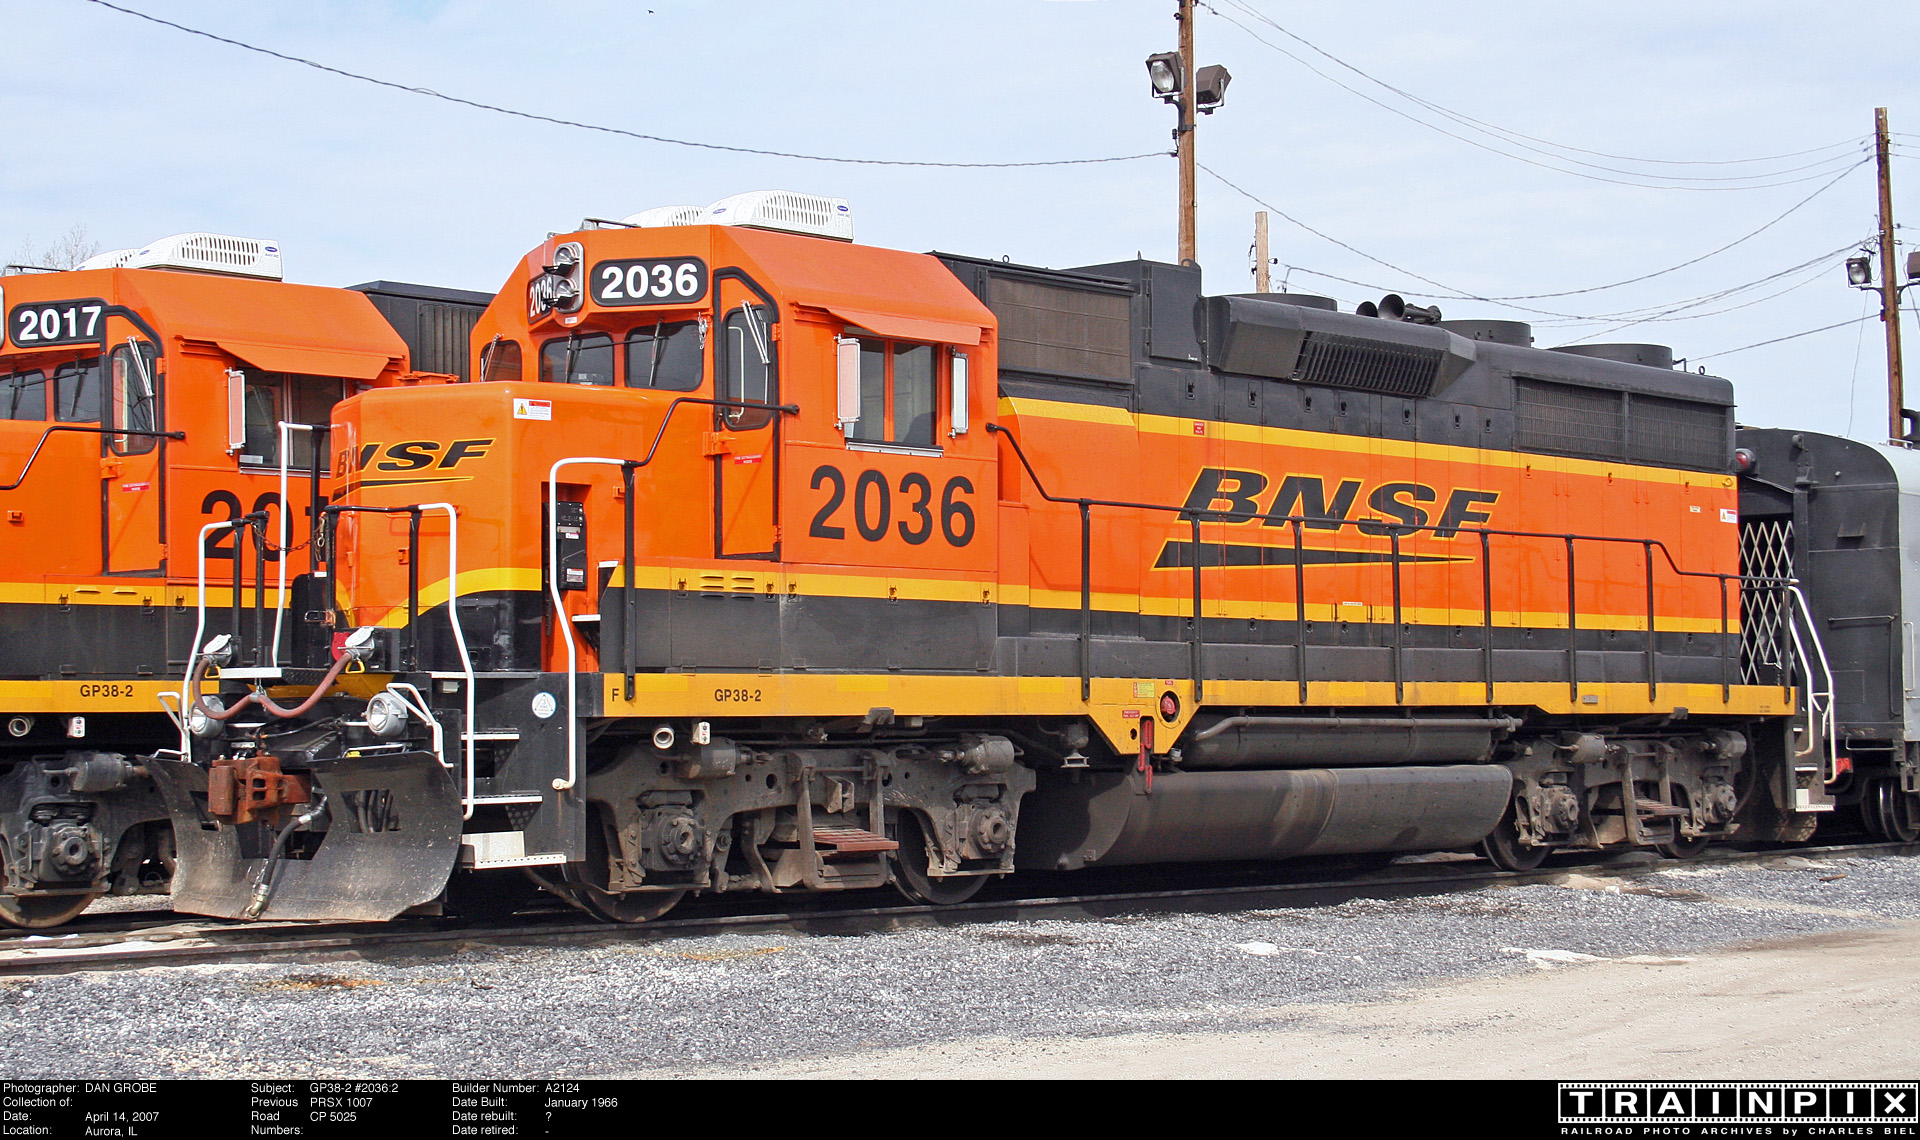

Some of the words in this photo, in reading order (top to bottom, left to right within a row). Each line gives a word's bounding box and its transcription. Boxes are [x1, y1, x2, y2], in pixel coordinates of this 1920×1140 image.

[601, 263, 699, 299] 2036
[19, 305, 102, 341] 2017
[335, 437, 496, 481] BNSF
[809, 465, 975, 548] 2036
[1174, 465, 1501, 541] BNSF
[80, 684, 133, 697] GP38-2
[611, 688, 620, 702] F
[714, 688, 762, 702] GP38-2
